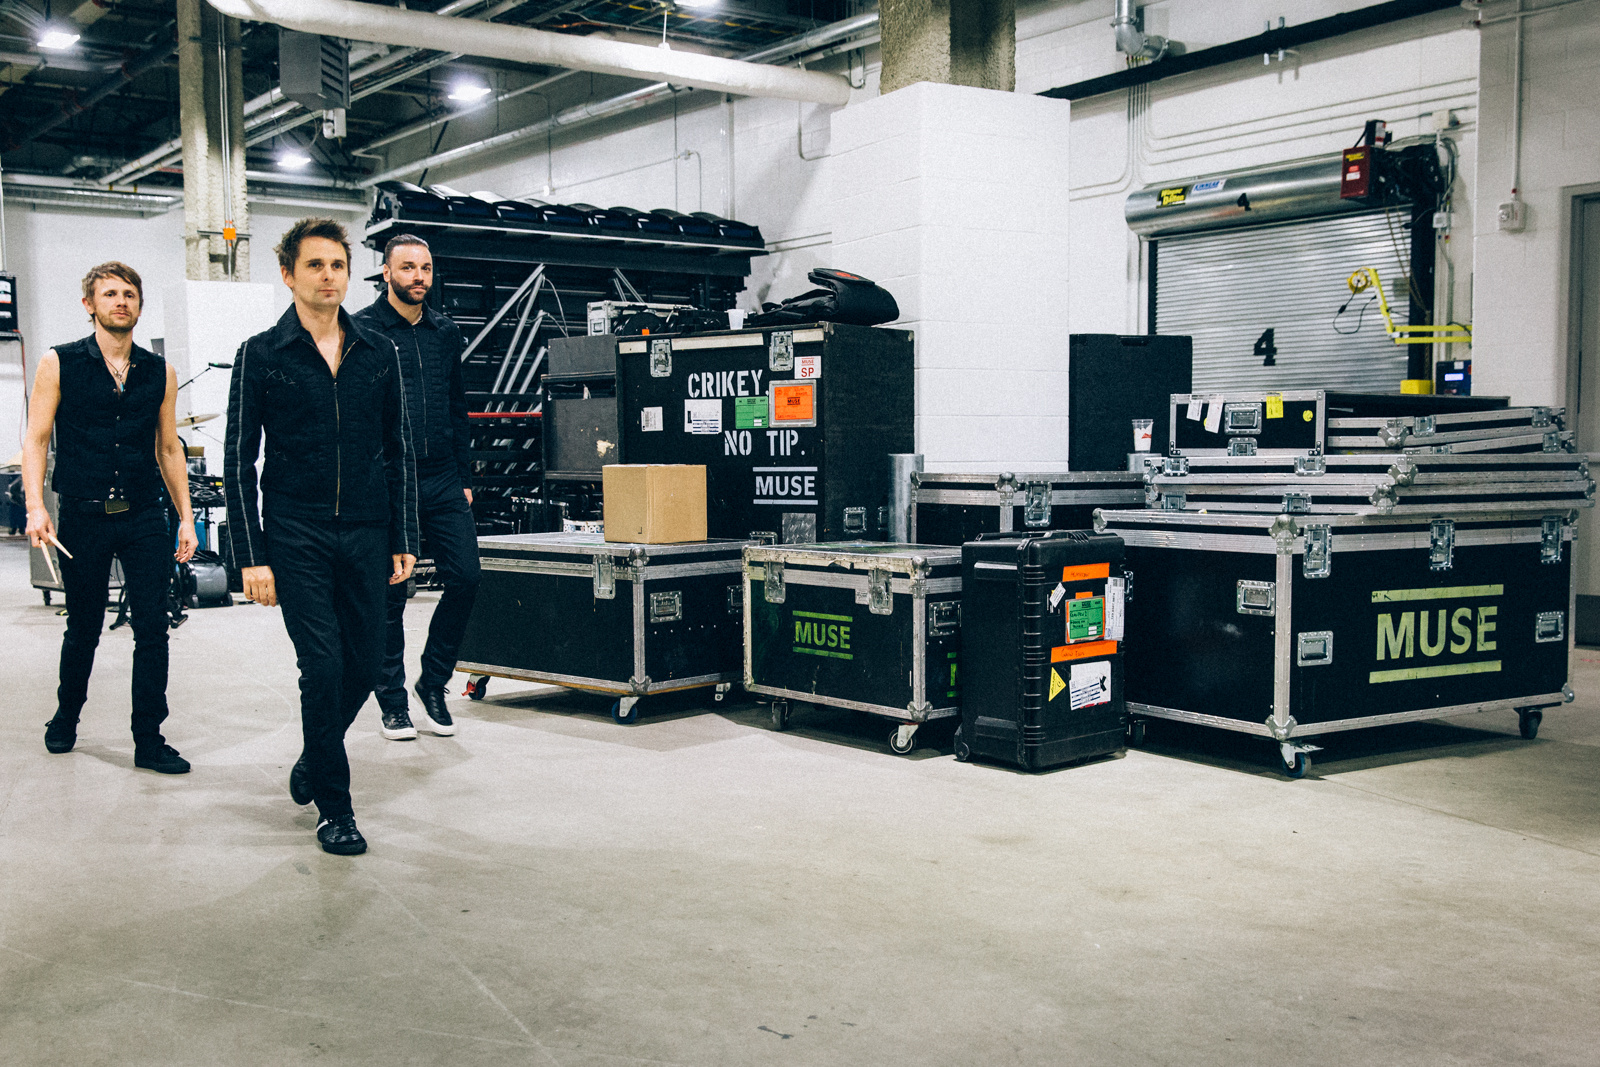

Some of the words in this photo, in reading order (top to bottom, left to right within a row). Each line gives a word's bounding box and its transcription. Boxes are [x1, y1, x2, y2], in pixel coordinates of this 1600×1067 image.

[1237, 193, 1251, 211] 4
[1253, 328, 1277, 366] 4
[801, 367, 815, 378] SP
[724, 430, 752, 456] NO
[755, 475, 816, 496] MUSE
[795, 621, 851, 649] MUSE
[1376, 606, 1498, 661] MUSE
